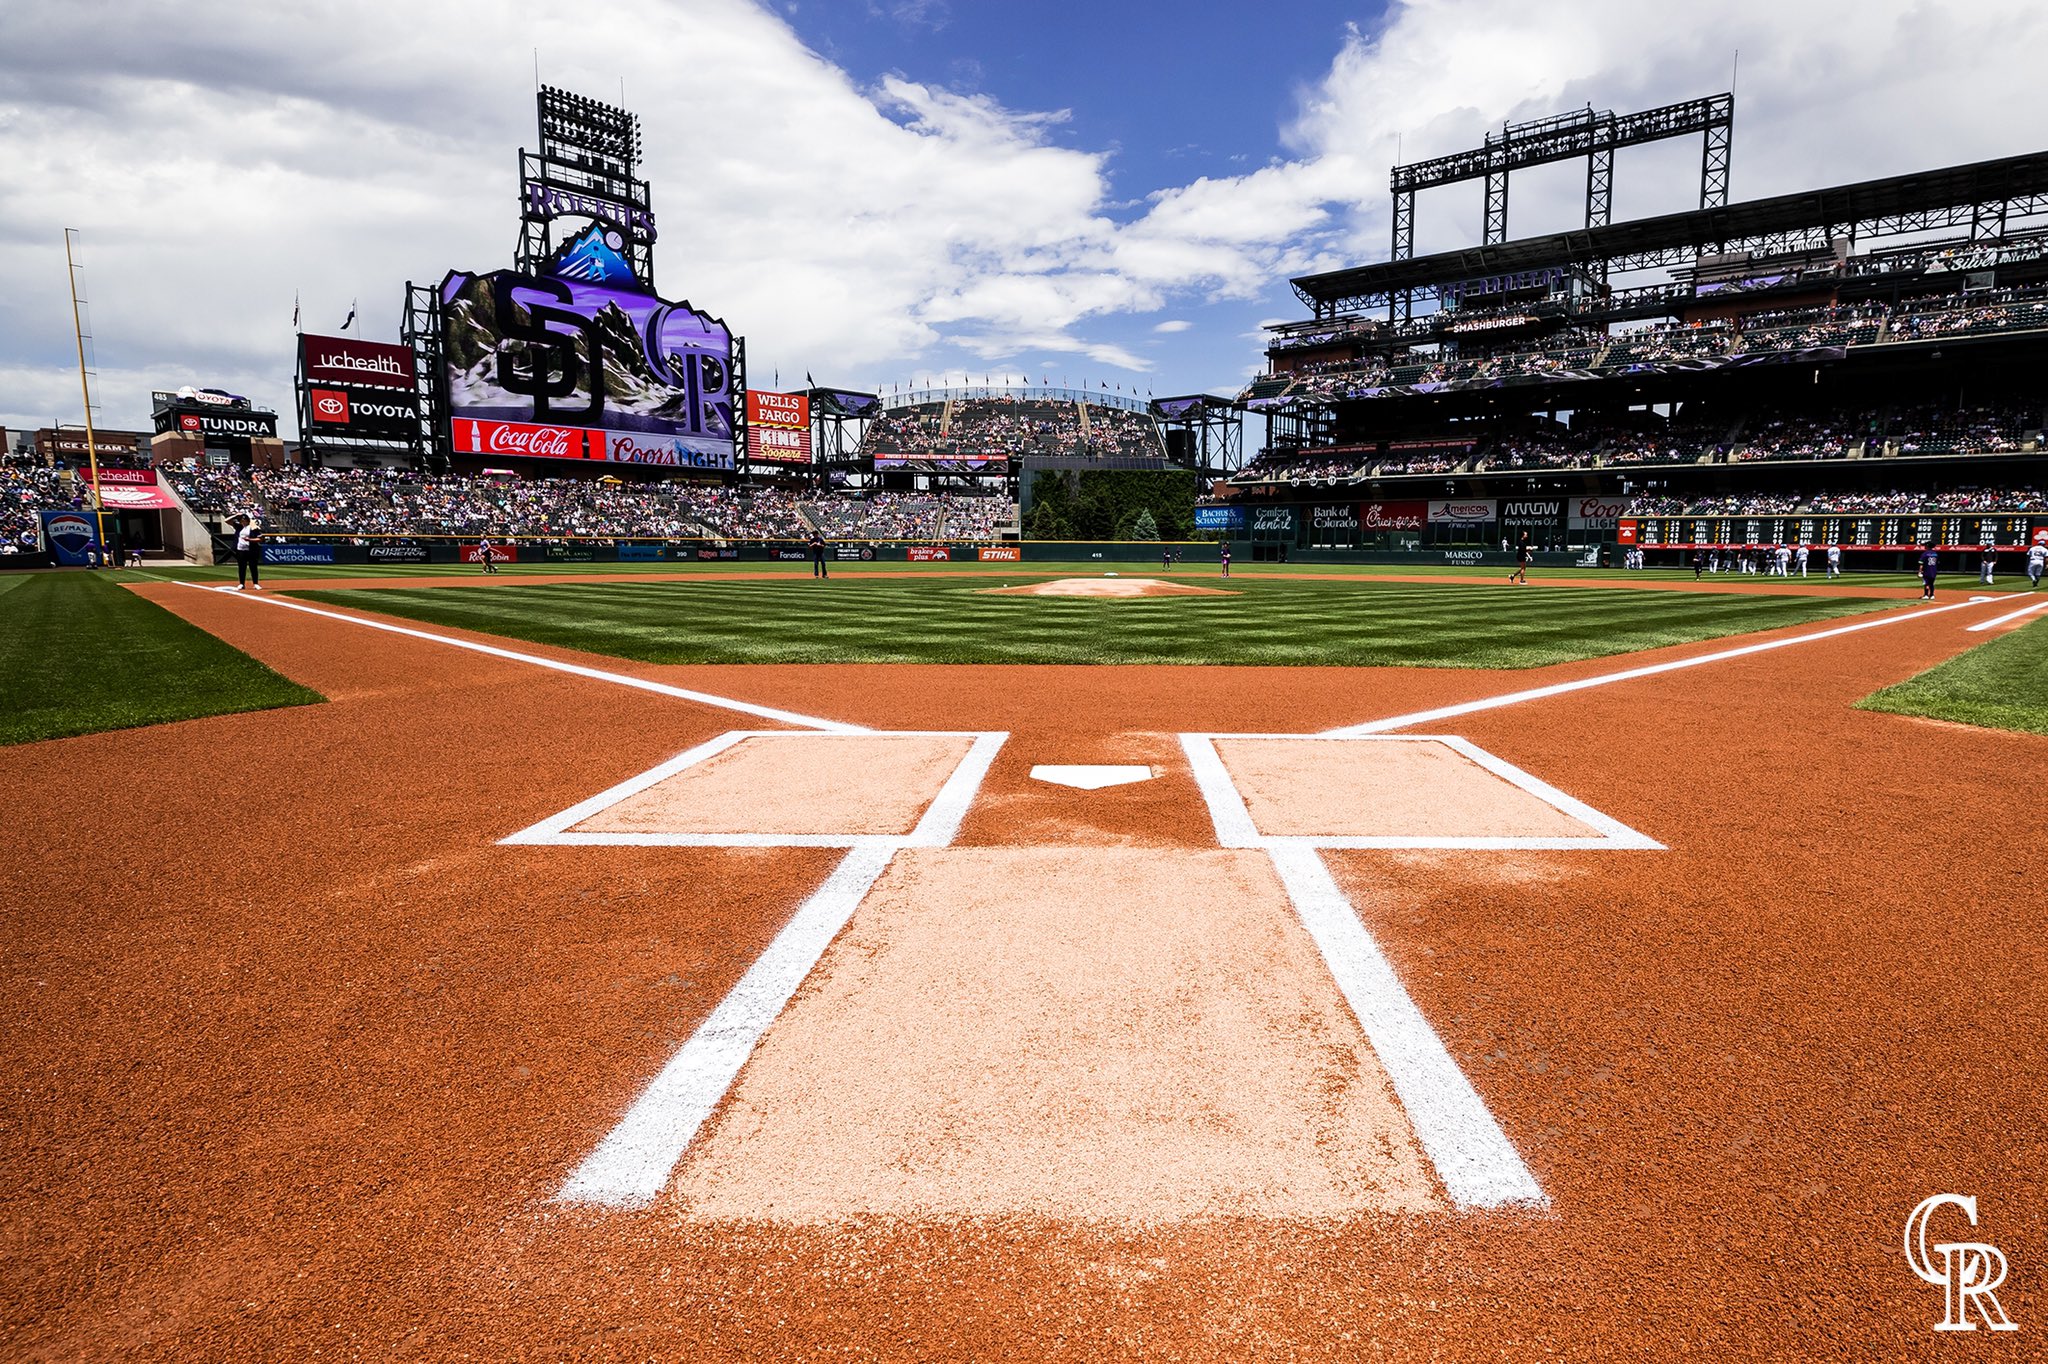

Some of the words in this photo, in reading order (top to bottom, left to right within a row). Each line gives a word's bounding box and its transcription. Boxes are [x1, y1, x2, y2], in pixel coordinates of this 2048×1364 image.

[526, 184, 658, 241] ROCKIES
[1769, 246, 1791, 256] JACK
[1453, 316, 1525, 333] SMASHBURGER
[321, 350, 401, 375] uchealth
[757, 393, 800, 410] WELLS
[349, 402, 416, 419] TOYOTA
[758, 408, 800, 424] FARGO
[200, 417, 271, 433] TUNDRA
[489, 424, 572, 455] Coca-Cola
[759, 429, 800, 447] KING
[612, 437, 677, 466] Coors
[678, 451, 728, 469] LIGHT
[759, 444, 802, 461] Soopers
[1228, 509, 1236, 517] &
[1256, 507, 1289, 517] Comfort
[1314, 506, 1337, 517] Bank
[1339, 505, 1349, 517] of
[1504, 502, 1560, 515] ARROW
[1580, 498, 1626, 518] Coor
[1313, 516, 1358, 529] Colorado
[1588, 519, 1617, 528] LIGH
